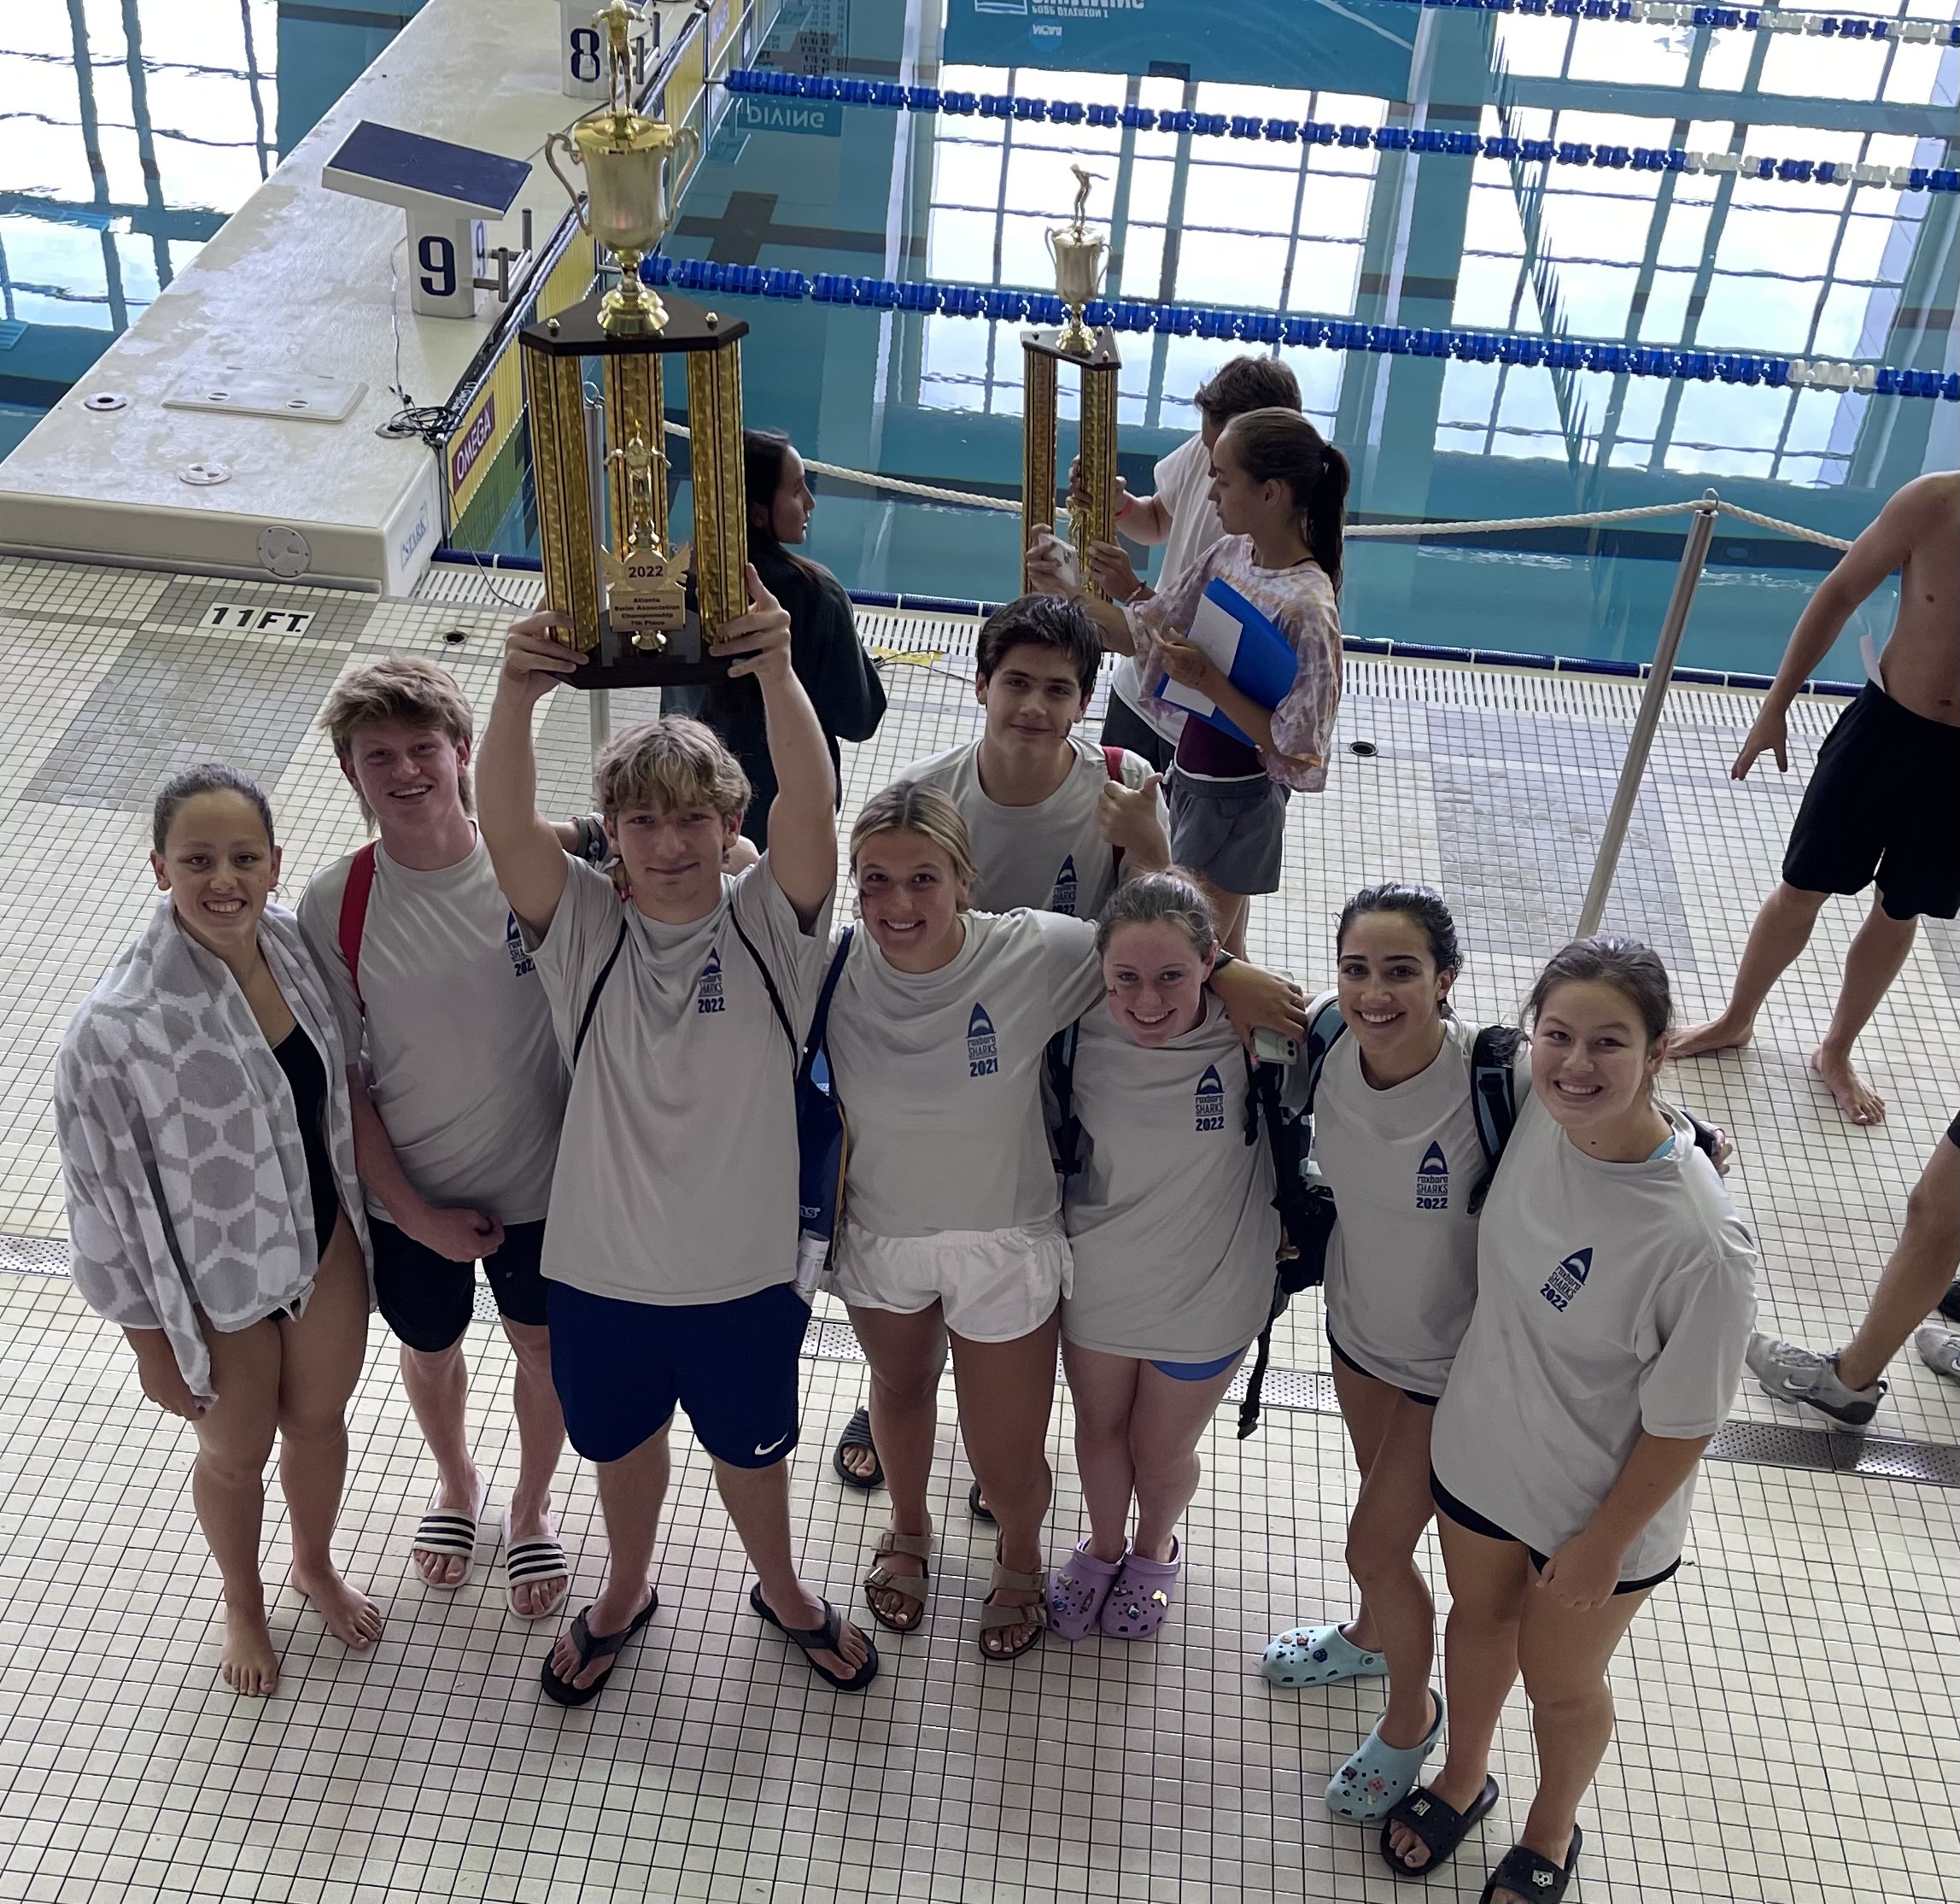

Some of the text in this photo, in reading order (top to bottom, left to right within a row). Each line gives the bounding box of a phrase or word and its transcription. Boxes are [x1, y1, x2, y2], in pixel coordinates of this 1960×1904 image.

[570, 28, 600, 82] 8
[418, 236, 456, 296] 9
[456, 407, 492, 481] OMEGA
[629, 565, 664, 578] 2022
[212, 606, 255, 627] 11
[514, 958, 536, 977] 202
[698, 997, 725, 1013] 2022
[968, 1044, 997, 1058] SHARKS
[969, 1057, 998, 1077] 2021
[1196, 1102, 1224, 1115] SHARKS
[1196, 1116, 1225, 1132] 2022
[1416, 1184, 1448, 1194] SHARKS
[1416, 1197, 1448, 1210] 2022
[1548, 1271, 1577, 1299] SHARKS
[1540, 1283, 1568, 1313] 2022
